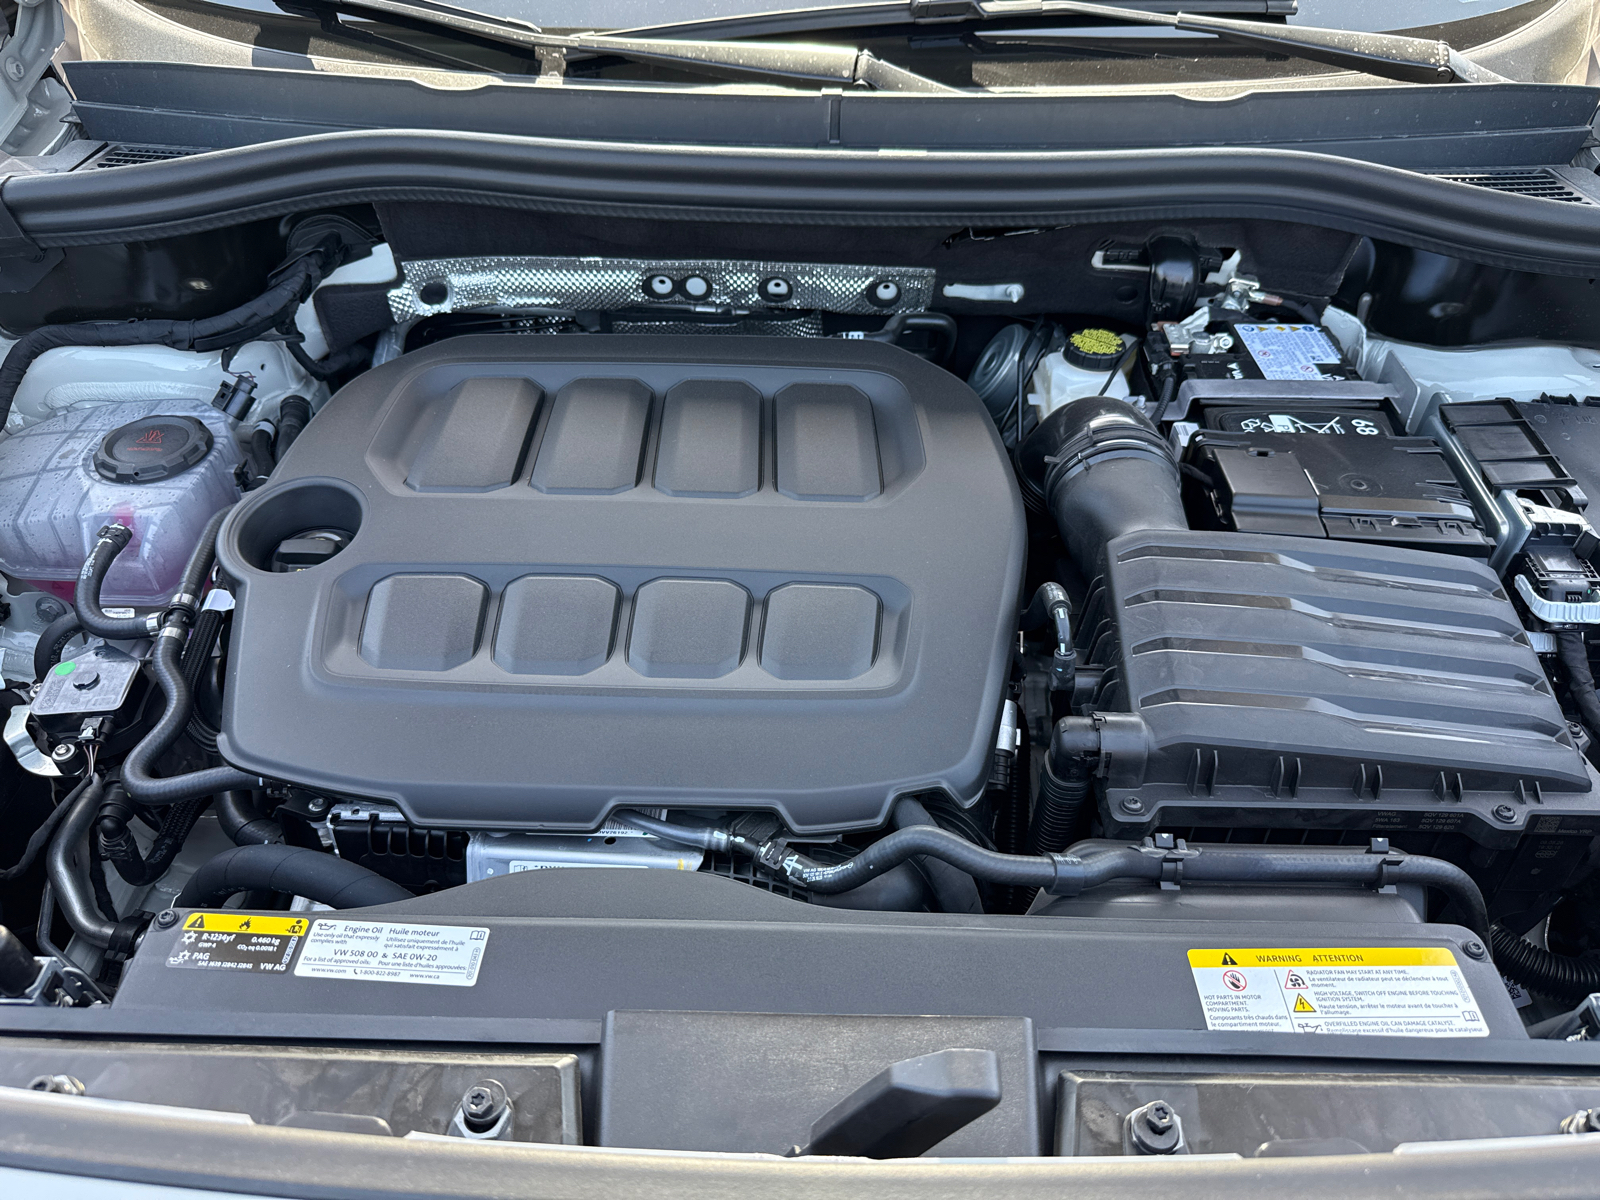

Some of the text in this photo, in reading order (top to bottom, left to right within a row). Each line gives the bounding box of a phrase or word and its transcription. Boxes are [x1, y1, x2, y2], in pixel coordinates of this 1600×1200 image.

[344, 925, 370, 934] Engine
[202, 933, 236, 943] R-1234yf
[272, 937, 281, 945] kg
[1256, 955, 1302, 963] WARNING
